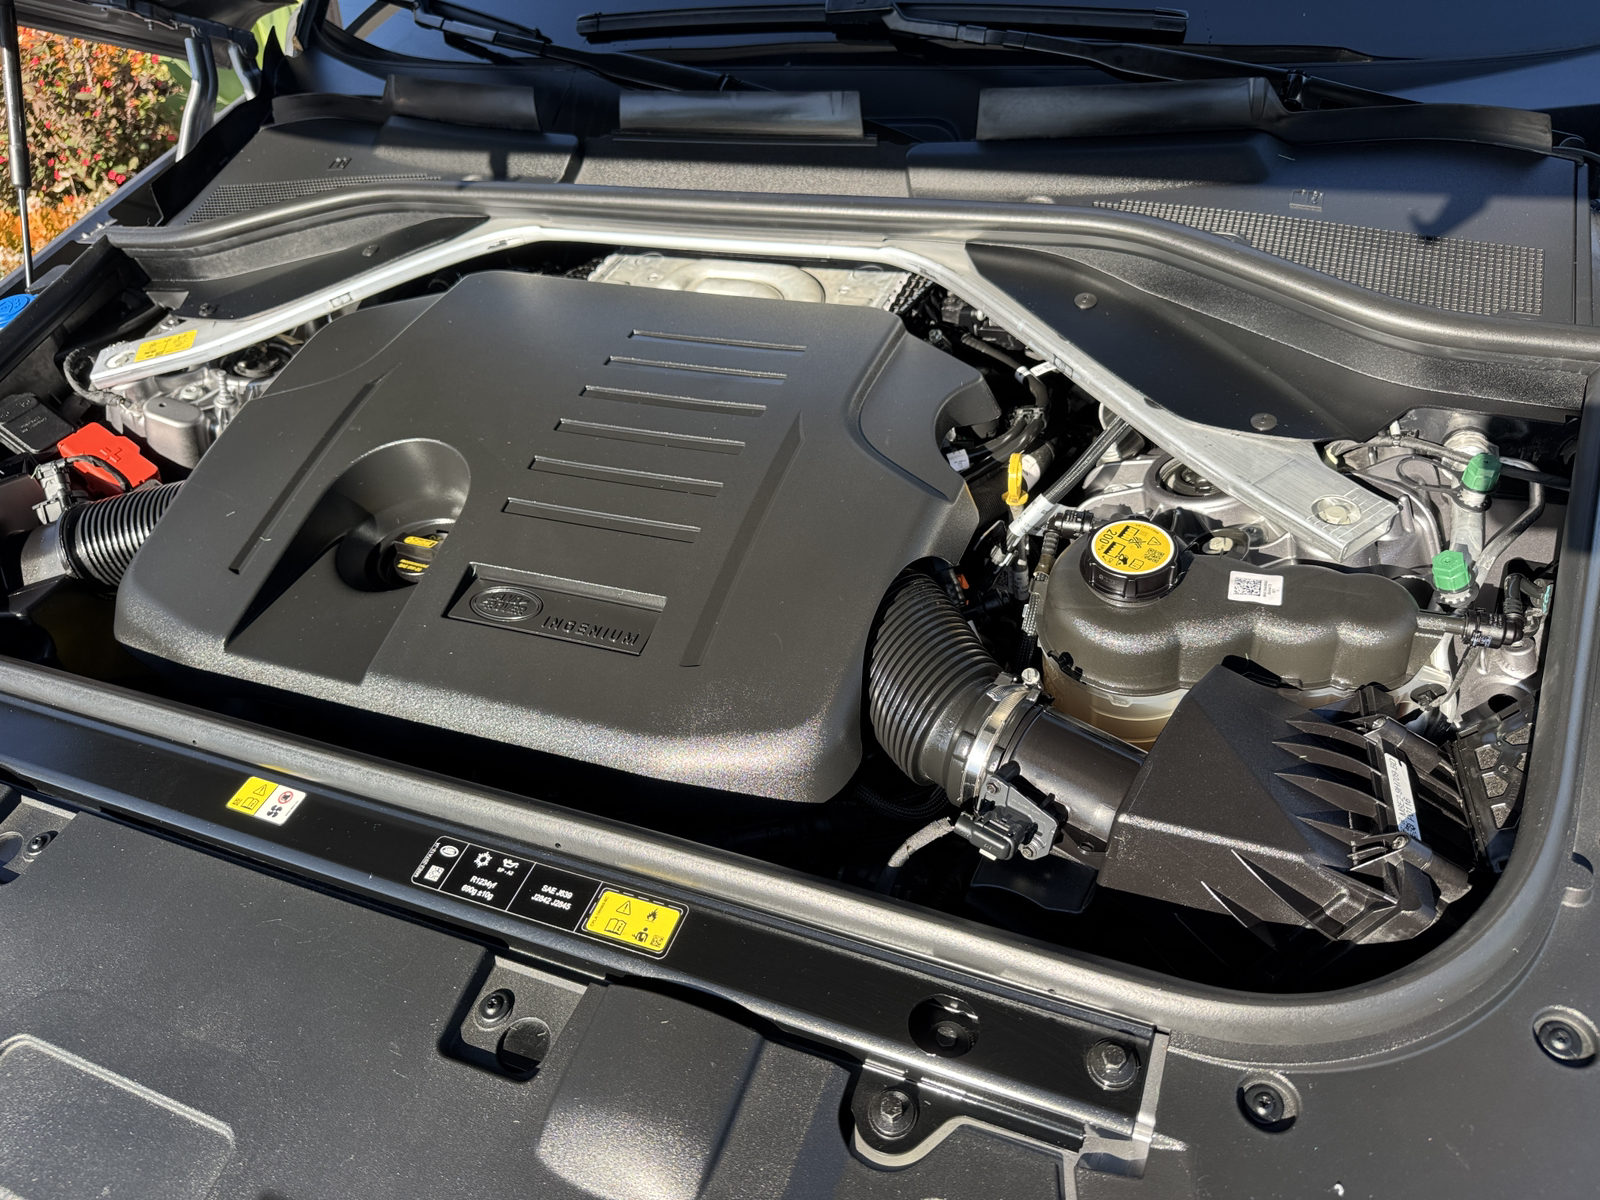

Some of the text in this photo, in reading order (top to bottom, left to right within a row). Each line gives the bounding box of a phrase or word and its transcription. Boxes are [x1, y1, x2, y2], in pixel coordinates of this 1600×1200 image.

[1099, 529, 1118, 545] 200
[541, 616, 640, 646] INGENIUM
[470, 875, 498, 890] R1234yf
[541, 885, 558, 895] SAE
